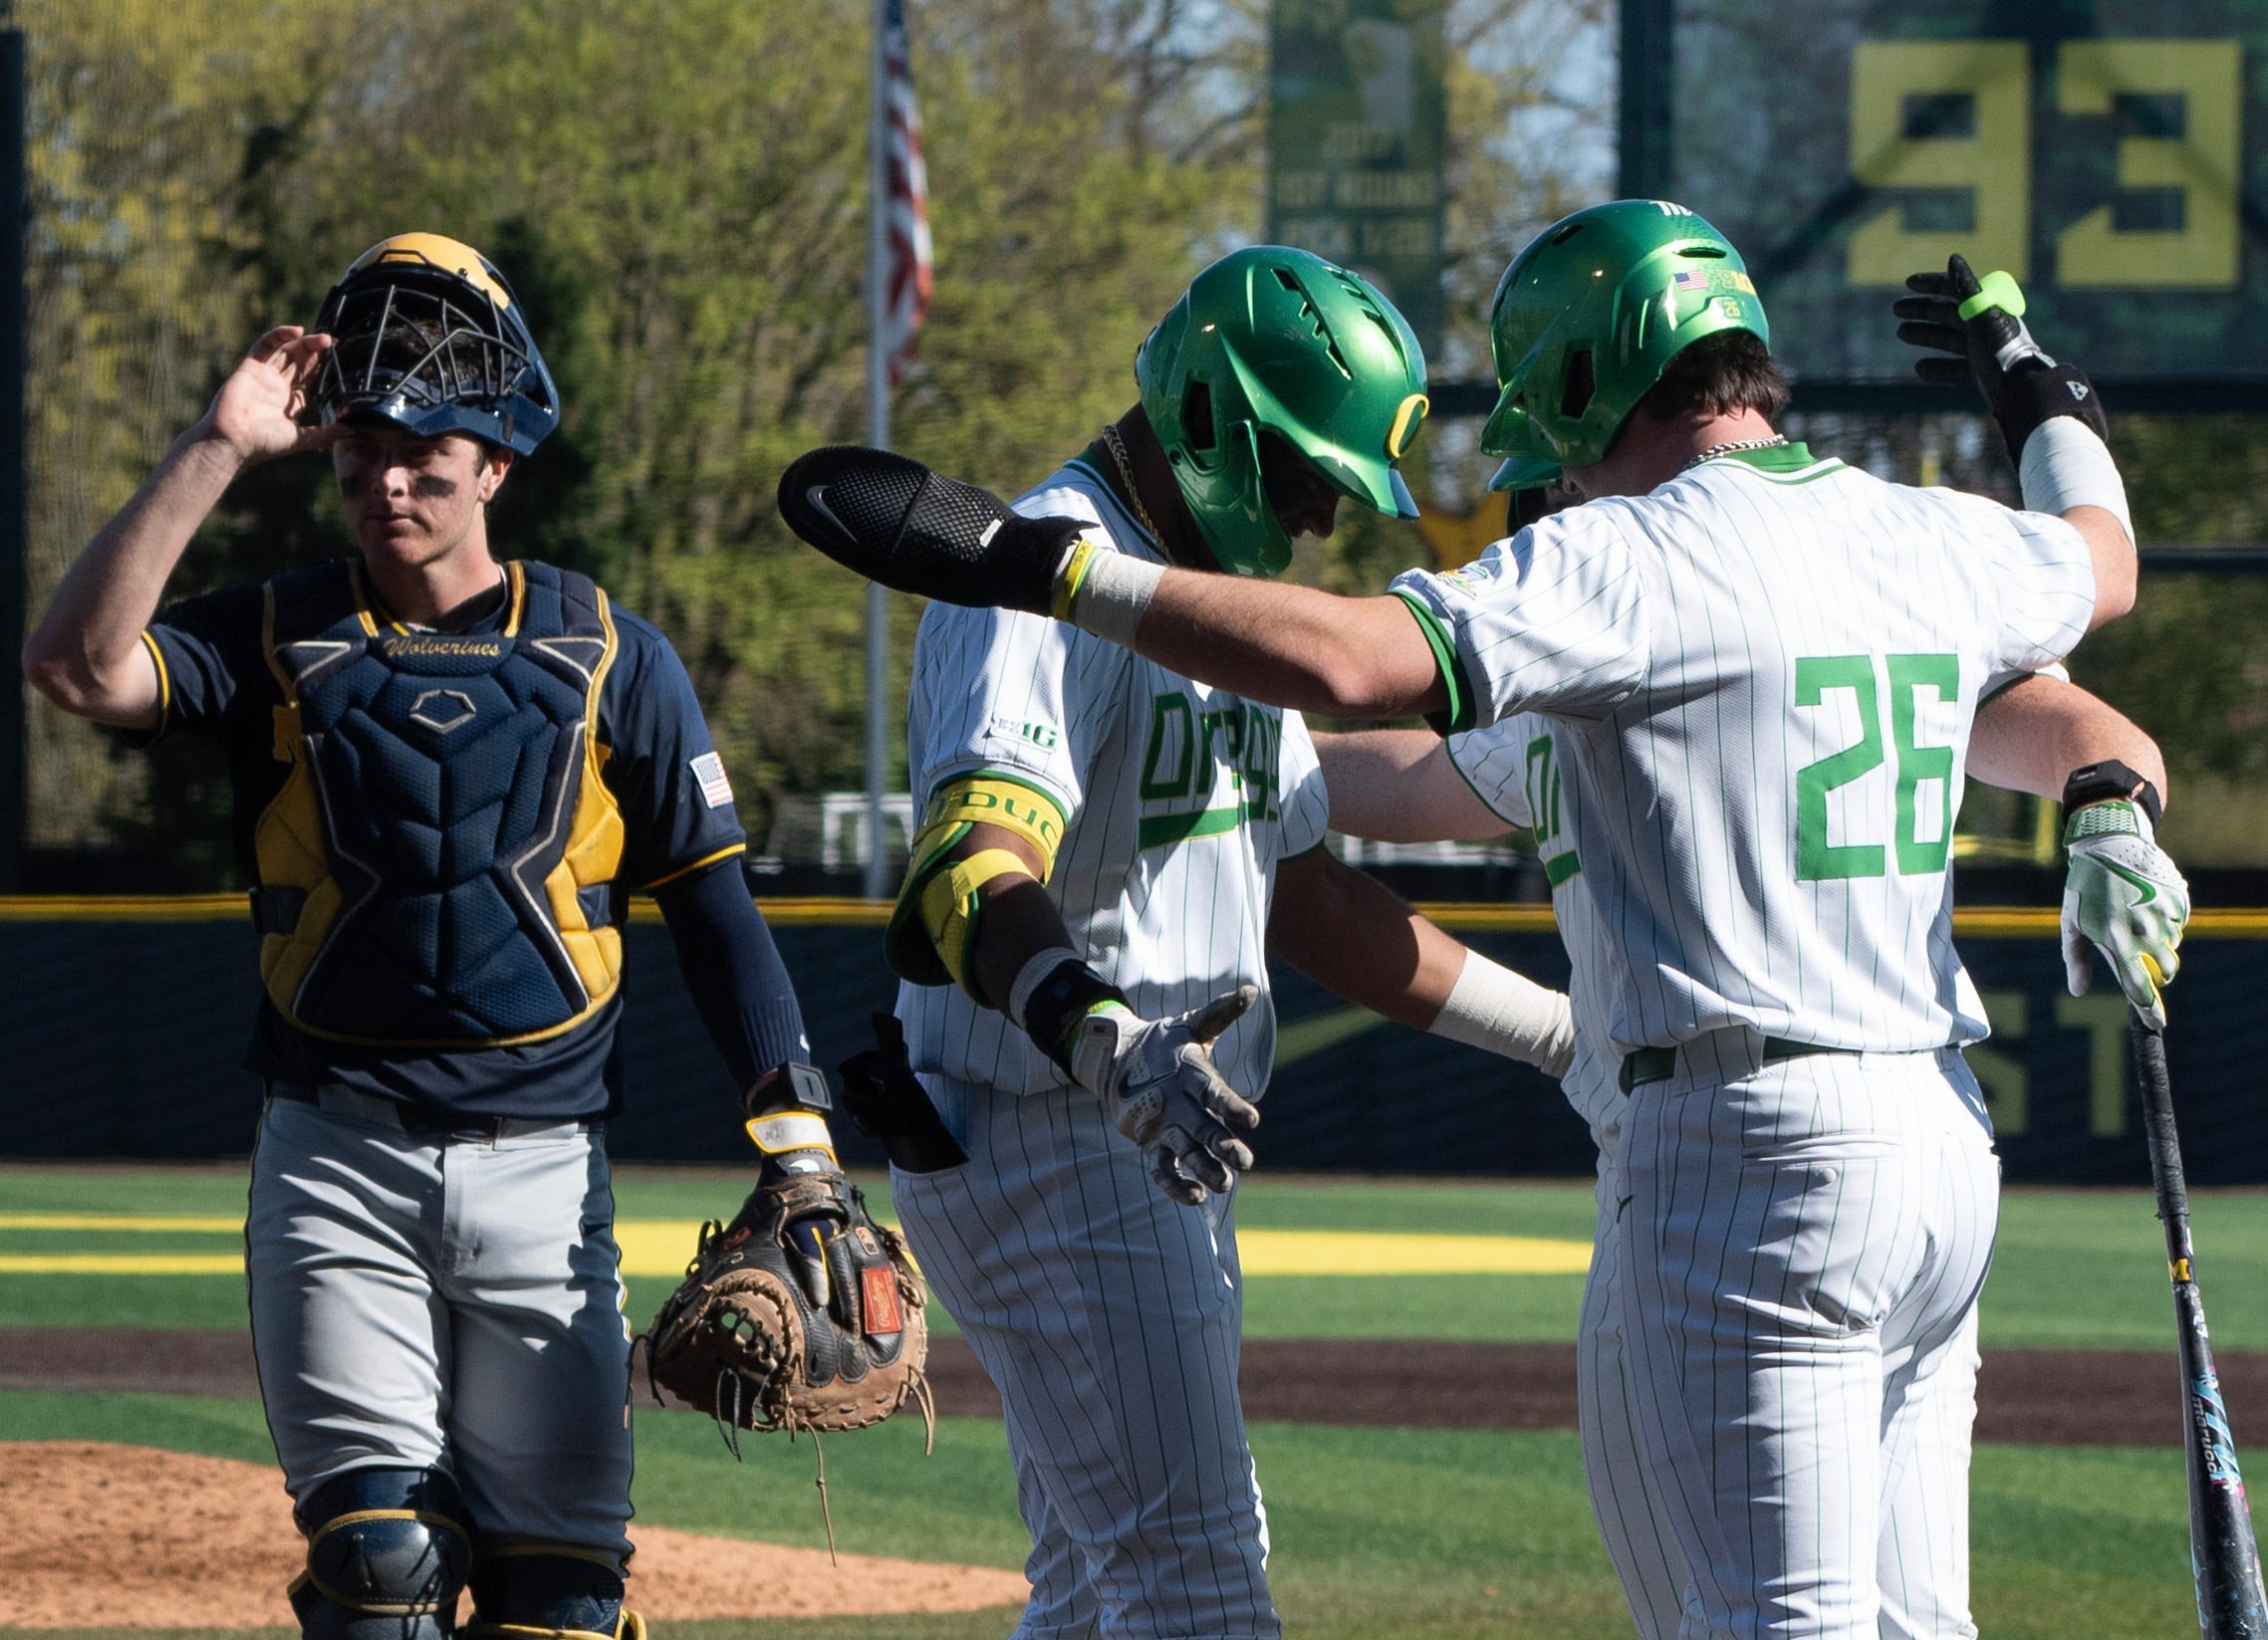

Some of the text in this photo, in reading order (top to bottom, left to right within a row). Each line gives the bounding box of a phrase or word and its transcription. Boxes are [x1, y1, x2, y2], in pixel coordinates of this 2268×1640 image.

[1848, 39, 2242, 287] 93
[383, 638, 500, 657] Wolverines
[1139, 691, 1281, 821] Oreg
[1794, 653, 1960, 881] 26
[961, 791, 1059, 860] DUC
